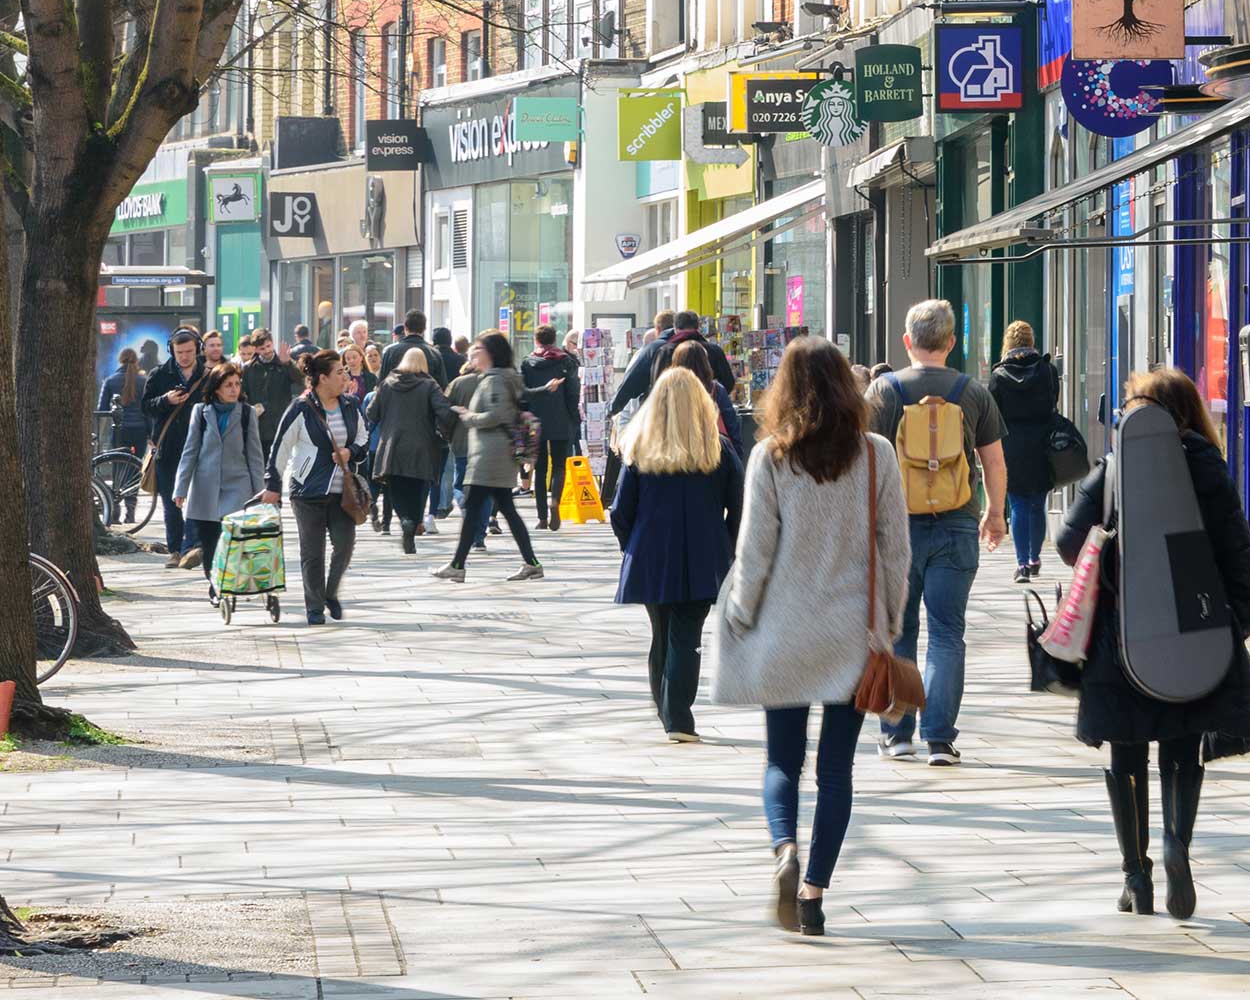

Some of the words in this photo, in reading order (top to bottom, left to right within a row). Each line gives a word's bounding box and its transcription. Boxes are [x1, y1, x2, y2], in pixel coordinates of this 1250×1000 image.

[864, 63, 914, 78] HOLLAND
[884, 76, 895, 88] &
[752, 89, 792, 106] Anya
[864, 89, 914, 104] BARRETT
[752, 113, 770, 123] 020
[772, 112, 796, 122] 7226
[449, 107, 488, 162] vision
[625, 102, 675, 156] scribbler
[377, 134, 408, 144] vision
[372, 146, 414, 157] express
[272, 196, 312, 233] JOY
